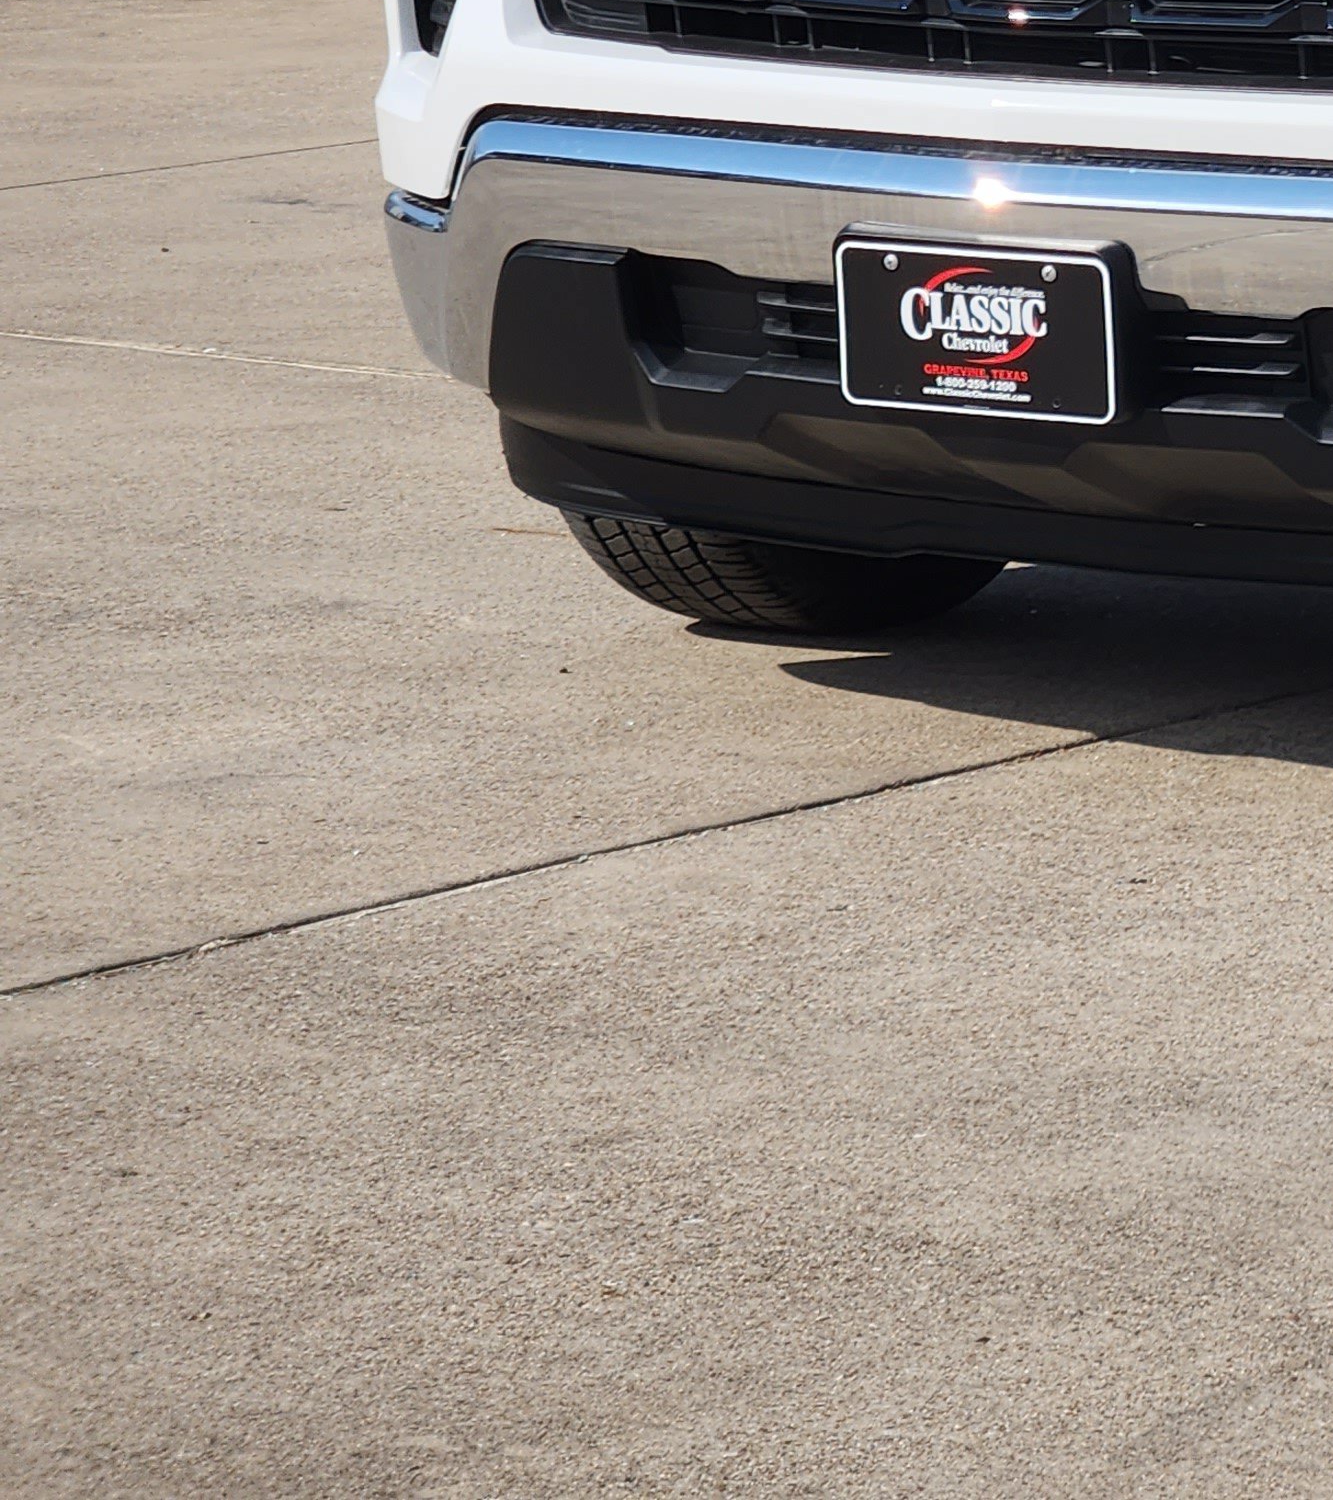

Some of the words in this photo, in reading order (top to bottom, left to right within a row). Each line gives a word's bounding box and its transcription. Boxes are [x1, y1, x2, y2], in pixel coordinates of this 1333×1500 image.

[901, 286, 1047, 341] CLASSIC
[942, 332, 1009, 354] Chevrolet
[923, 363, 989, 380] GRAPEVINE,
[990, 369, 1029, 382] TEXAS
